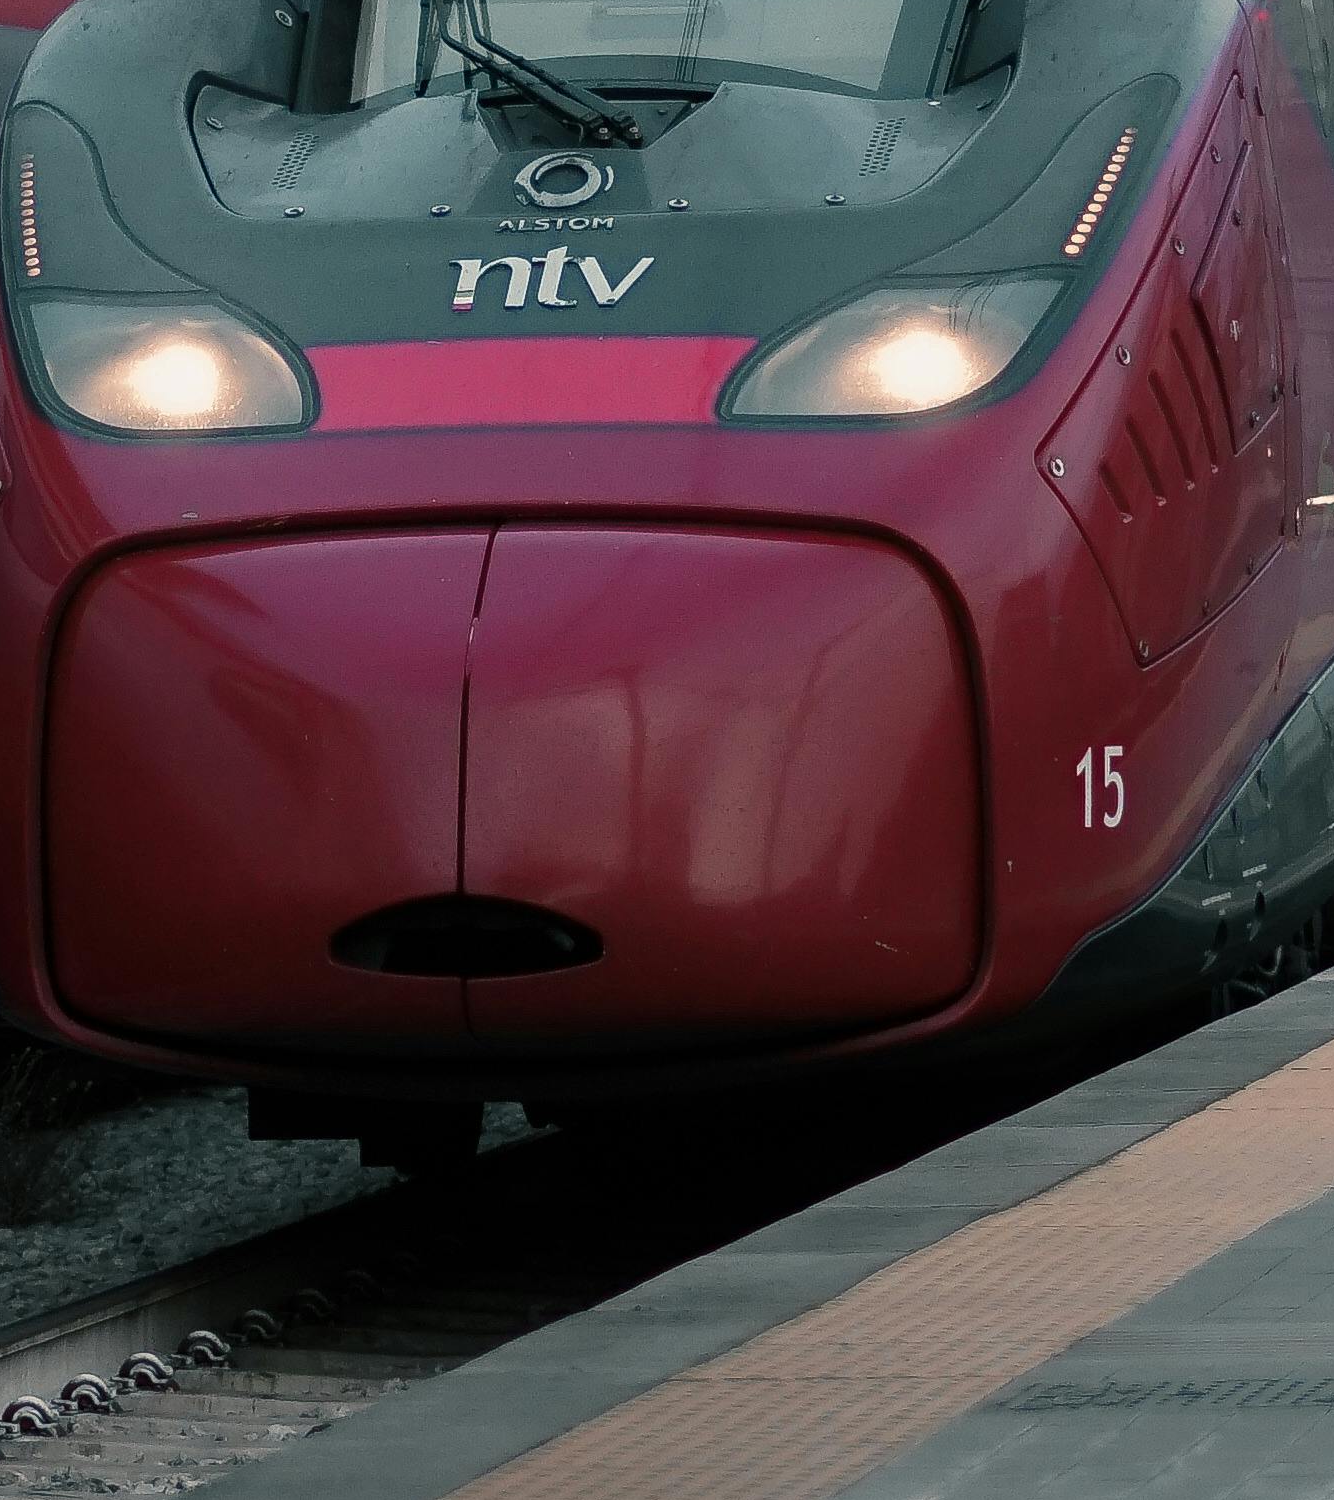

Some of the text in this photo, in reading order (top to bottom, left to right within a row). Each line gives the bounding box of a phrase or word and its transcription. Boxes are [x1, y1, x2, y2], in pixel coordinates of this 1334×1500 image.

[495, 216, 614, 233] ALSTOM
[449, 245, 654, 312] ntv
[1076, 745, 1124, 828] 15
